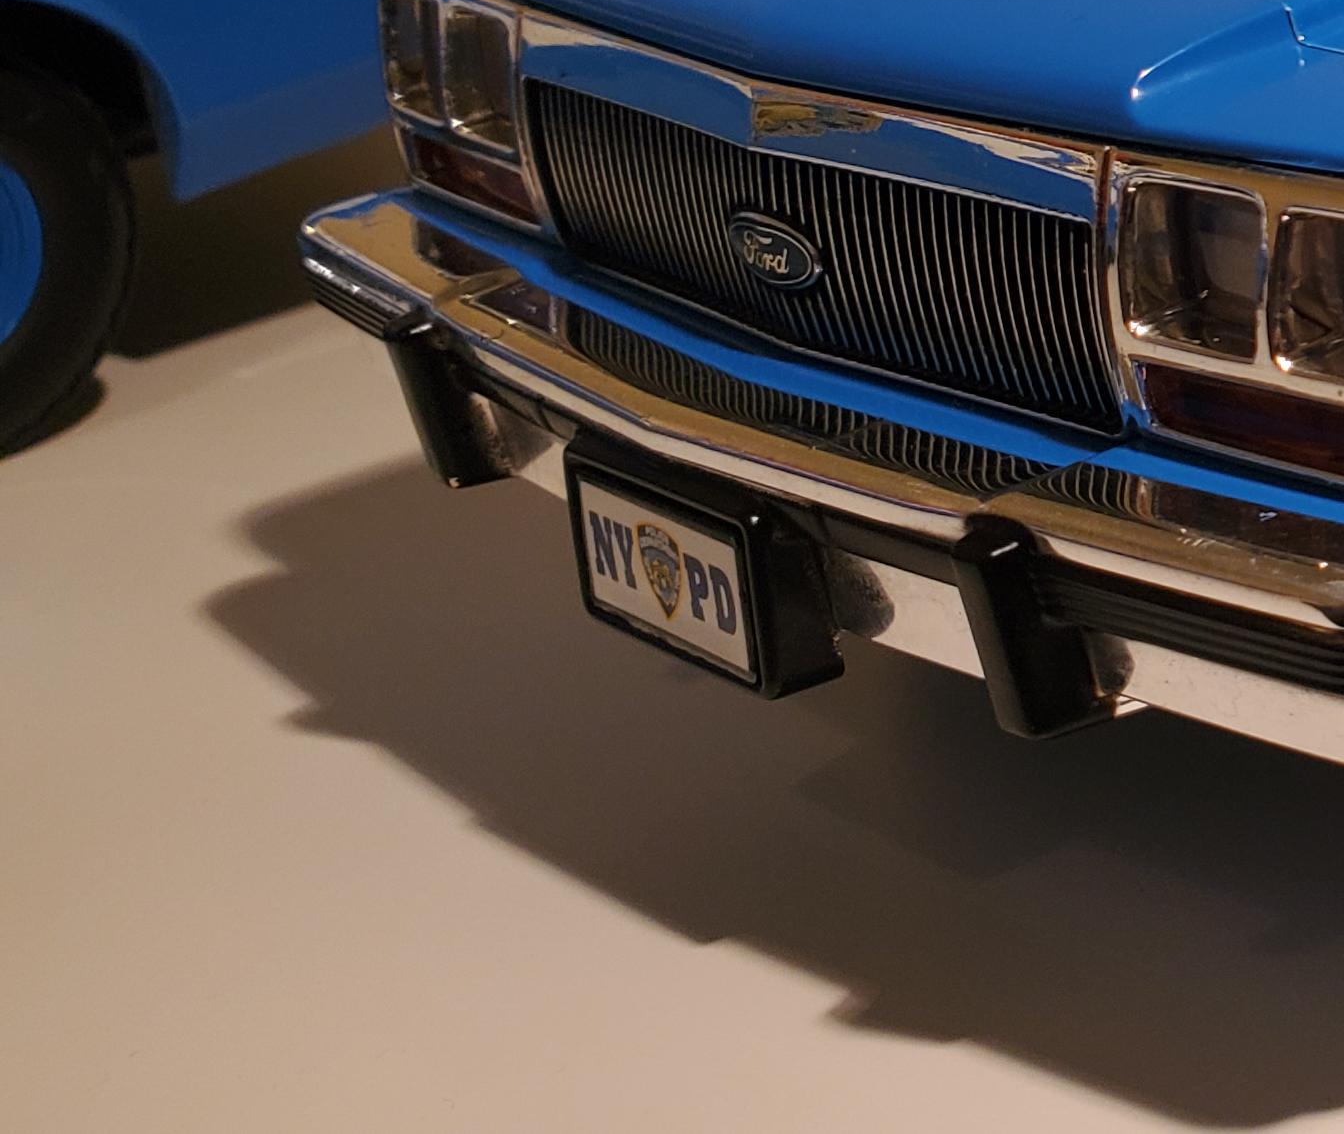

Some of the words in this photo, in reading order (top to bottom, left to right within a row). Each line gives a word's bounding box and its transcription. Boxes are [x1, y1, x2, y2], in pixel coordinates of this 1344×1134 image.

[743, 230, 790, 274] Ford
[589, 510, 638, 590] NY
[682, 552, 738, 636] PD
